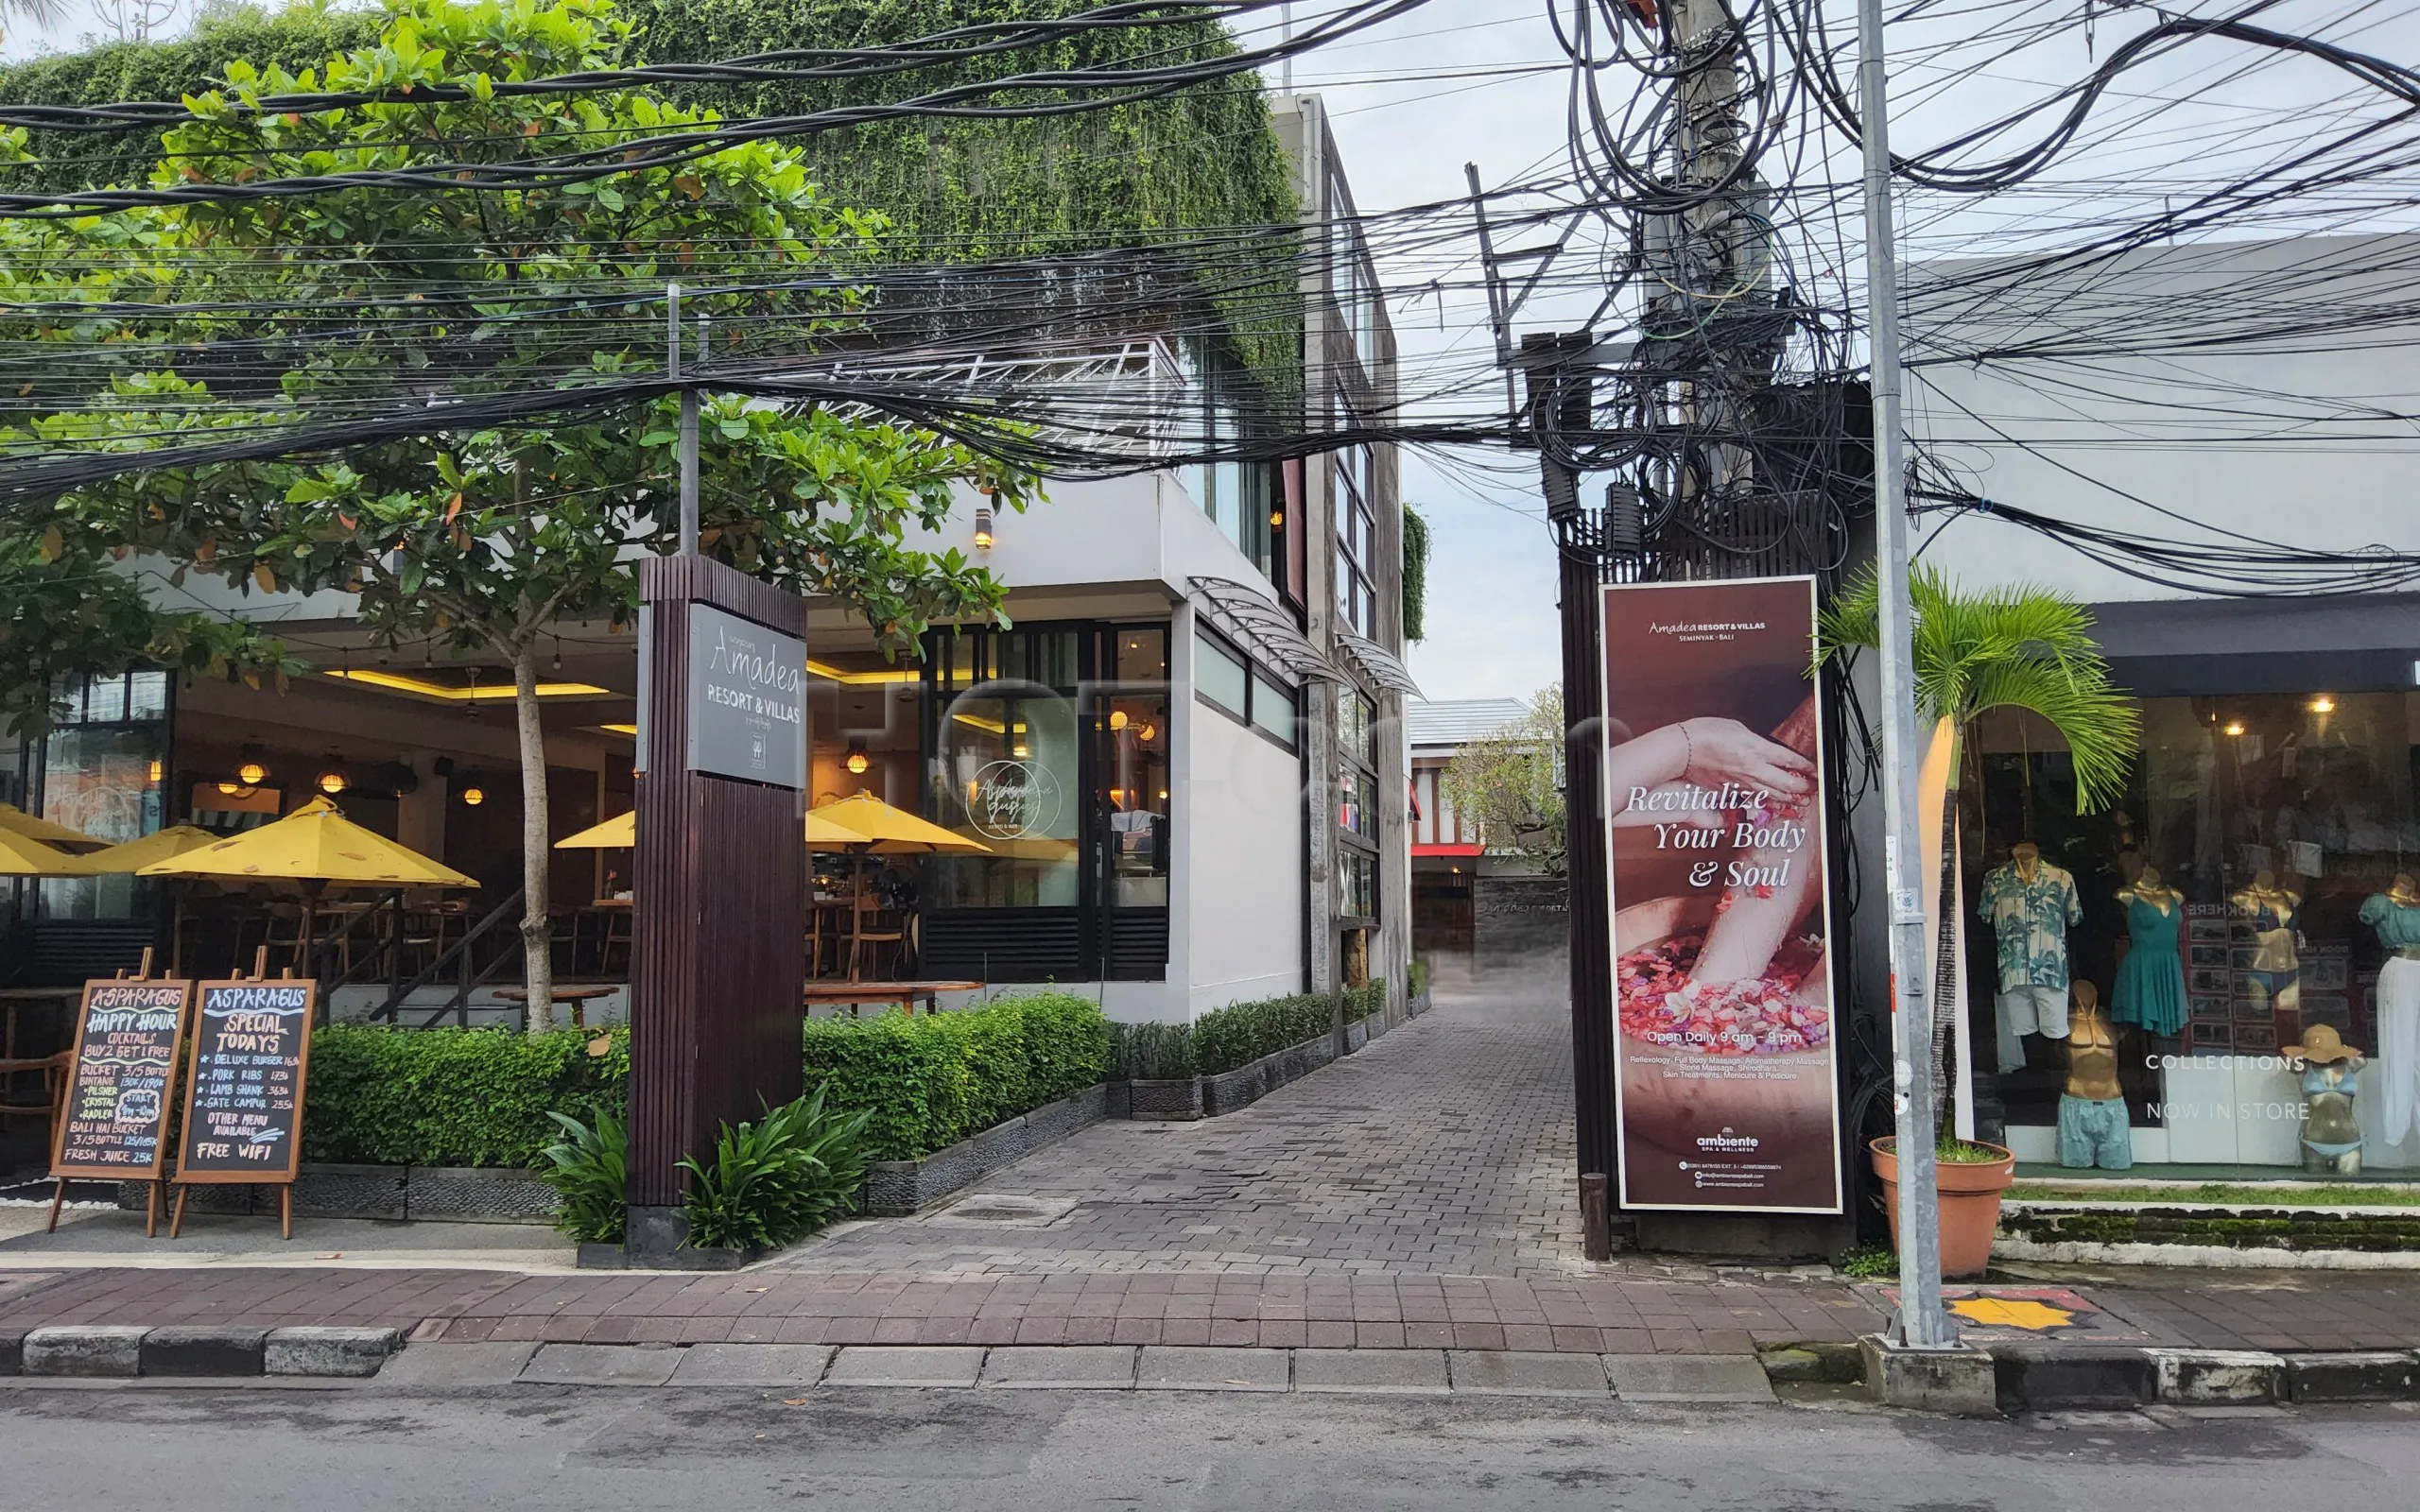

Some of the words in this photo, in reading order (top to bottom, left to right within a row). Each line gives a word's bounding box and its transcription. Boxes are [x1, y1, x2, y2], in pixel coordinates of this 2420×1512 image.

[1649, 620, 1697, 635] Amadea
[710, 625, 800, 696] Amadea
[708, 683, 753, 712] RESORT
[755, 698, 764, 714] &
[764, 699, 801, 725] VILLAS
[1627, 782, 1769, 812] Revitalize
[1654, 823, 1725, 850] Your
[1732, 820, 1806, 853] Body
[1689, 861, 1719, 887] &
[1724, 859, 1790, 887] Soul
[91, 988, 182, 1007] ASPARAGUS
[207, 988, 306, 1008] ASPARAGUS
[86, 1013, 137, 1033] HAPPY
[135, 1013, 178, 1030] HOUR
[224, 1013, 290, 1035] SPECIAL
[107, 1032, 157, 1045] COCKTAILS
[1647, 1031, 1682, 1044] Open
[1685, 1031, 1718, 1046] Daily
[1720, 1031, 1728, 1042] 9
[1731, 1033, 1754, 1042] am
[1768, 1031, 1776, 1042] 9
[1779, 1033, 1803, 1046] pm
[116, 1045, 141, 1057] GET
[147, 1046, 171, 1057] FREE
[214, 1054, 250, 1065] DELUXE
[251, 1056, 284, 1065] BURGER
[1688, 1057, 1707, 1066] Body
[1744, 1057, 1795, 1066] Aromatherapy
[2145, 1055, 2306, 1072] COLLECTIONS
[80, 1064, 120, 1076] BUCKET
[122, 1065, 144, 1077] 3/5
[145, 1066, 170, 1076] BOTTLE
[212, 1069, 235, 1081] PORK
[241, 1070, 263, 1081] RIBS
[78, 1076, 114, 1087] BINTANG
[87, 1086, 118, 1096] PILSNER
[210, 1084, 233, 1095] LAMB
[235, 1085, 265, 1096] SHANK
[84, 1097, 117, 1108] CRYSTAL
[126, 1094, 152, 1104] START
[233, 1098, 267, 1110] CAMPUR
[82, 1108, 113, 1120] RADLER
[2147, 1102, 2201, 1119] NOW
[2209, 1103, 2231, 1119] IN
[2240, 1103, 2311, 1120] STORE
[207, 1111, 238, 1125] OTHER
[241, 1114, 268, 1126] MENU
[69, 1121, 94, 1133] BALI
[95, 1123, 112, 1134] HAI
[112, 1124, 147, 1134] BUCKET
[213, 1125, 258, 1137] AVAILABLE
[73, 1135, 95, 1145] 3/5
[95, 1135, 123, 1145] BOTTLE
[1696, 1133, 1759, 1147] ambiente
[64, 1148, 97, 1160] FRESH
[100, 1150, 130, 1163] JUICE
[197, 1143, 231, 1160] FREE
[238, 1143, 272, 1160] WIFI
